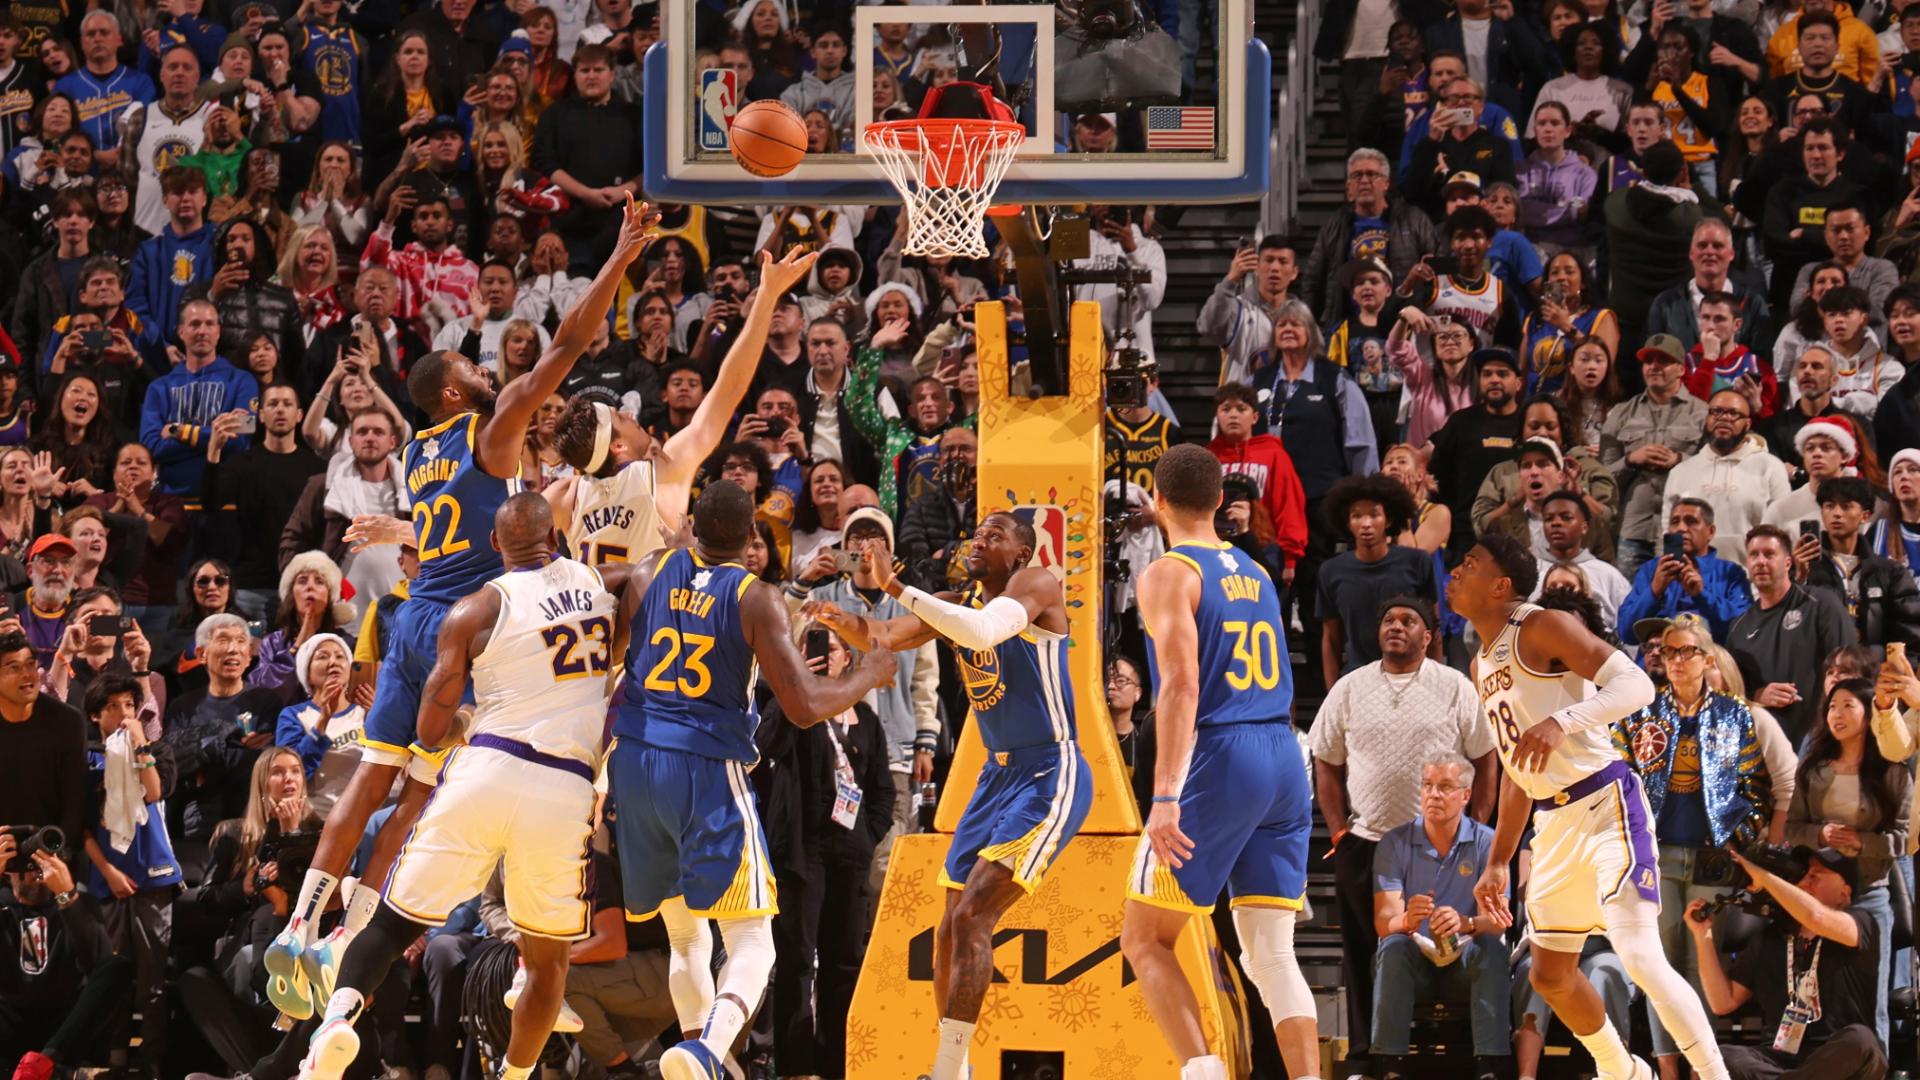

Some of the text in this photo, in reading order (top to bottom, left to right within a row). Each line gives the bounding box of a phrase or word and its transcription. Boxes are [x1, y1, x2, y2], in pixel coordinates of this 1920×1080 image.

[706, 132, 724, 145] NBA
[1371, 240, 1386, 250] 30
[1114, 444, 1164, 464] FANCISCO
[408, 458, 459, 495] WIGGINS
[412, 494, 471, 562] 22
[582, 505, 635, 534] REAVES
[669, 588, 716, 619] GREEN
[1221, 574, 1261, 602] CURRY
[538, 589, 593, 621] JAMES
[541, 616, 611, 682] 23
[644, 626, 716, 698] 23
[973, 648, 994, 668] 00
[1223, 620, 1280, 691] 30
[1488, 700, 1521, 754] 28
[1680, 745, 1699, 758] 30
